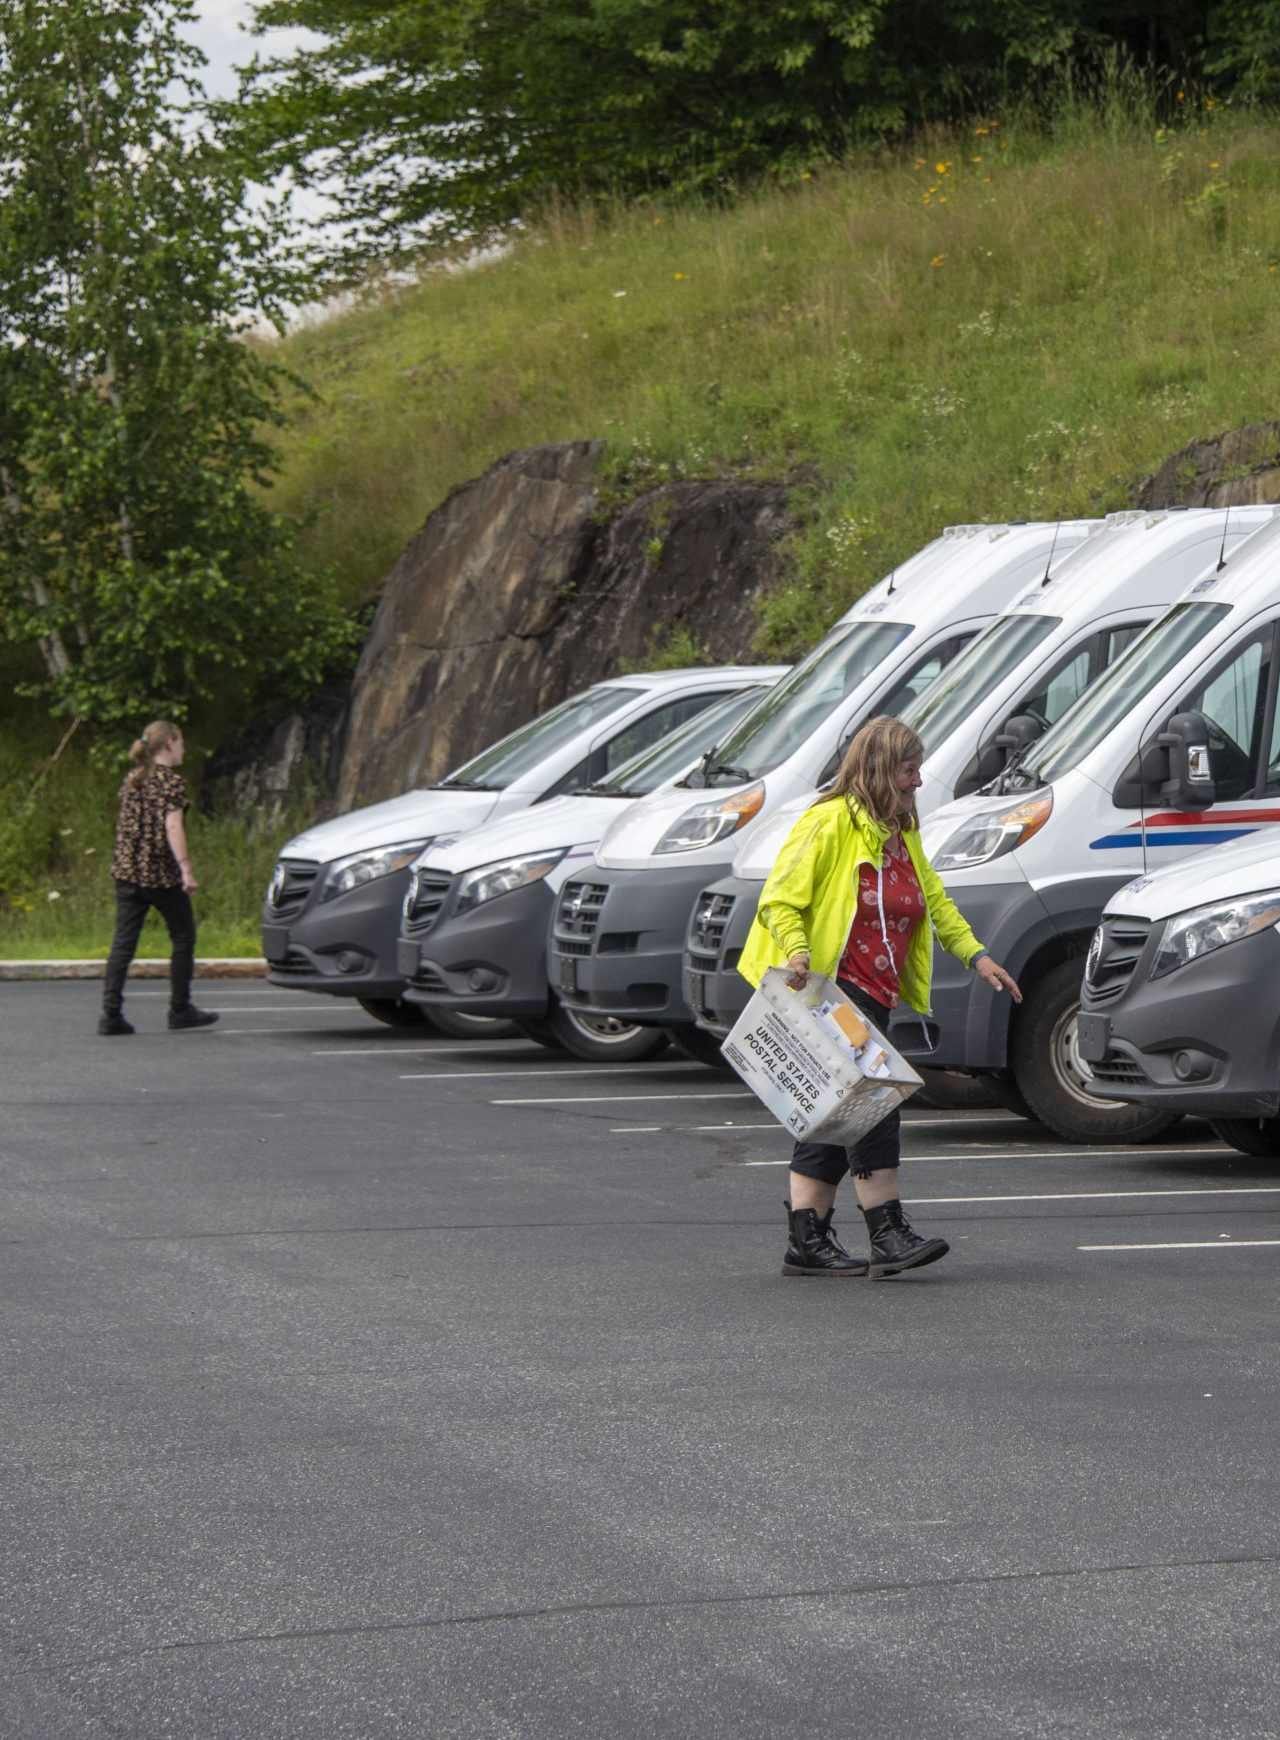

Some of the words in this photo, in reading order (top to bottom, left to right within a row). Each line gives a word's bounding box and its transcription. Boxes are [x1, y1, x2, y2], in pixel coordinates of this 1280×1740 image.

[744, 1033, 779, 1072] POSTAL
[776, 1071, 815, 1114] SERVICE
[755, 1026, 788, 1063] UNITED
[785, 1060, 821, 1099] STATES
[770, 1012, 789, 1033] WARNING
[790, 1034, 799, 1045] NOT
[798, 1043, 808, 1054] FOR
[806, 1052, 824, 1071] PRIVATE
[821, 1069, 831, 1080] USE
